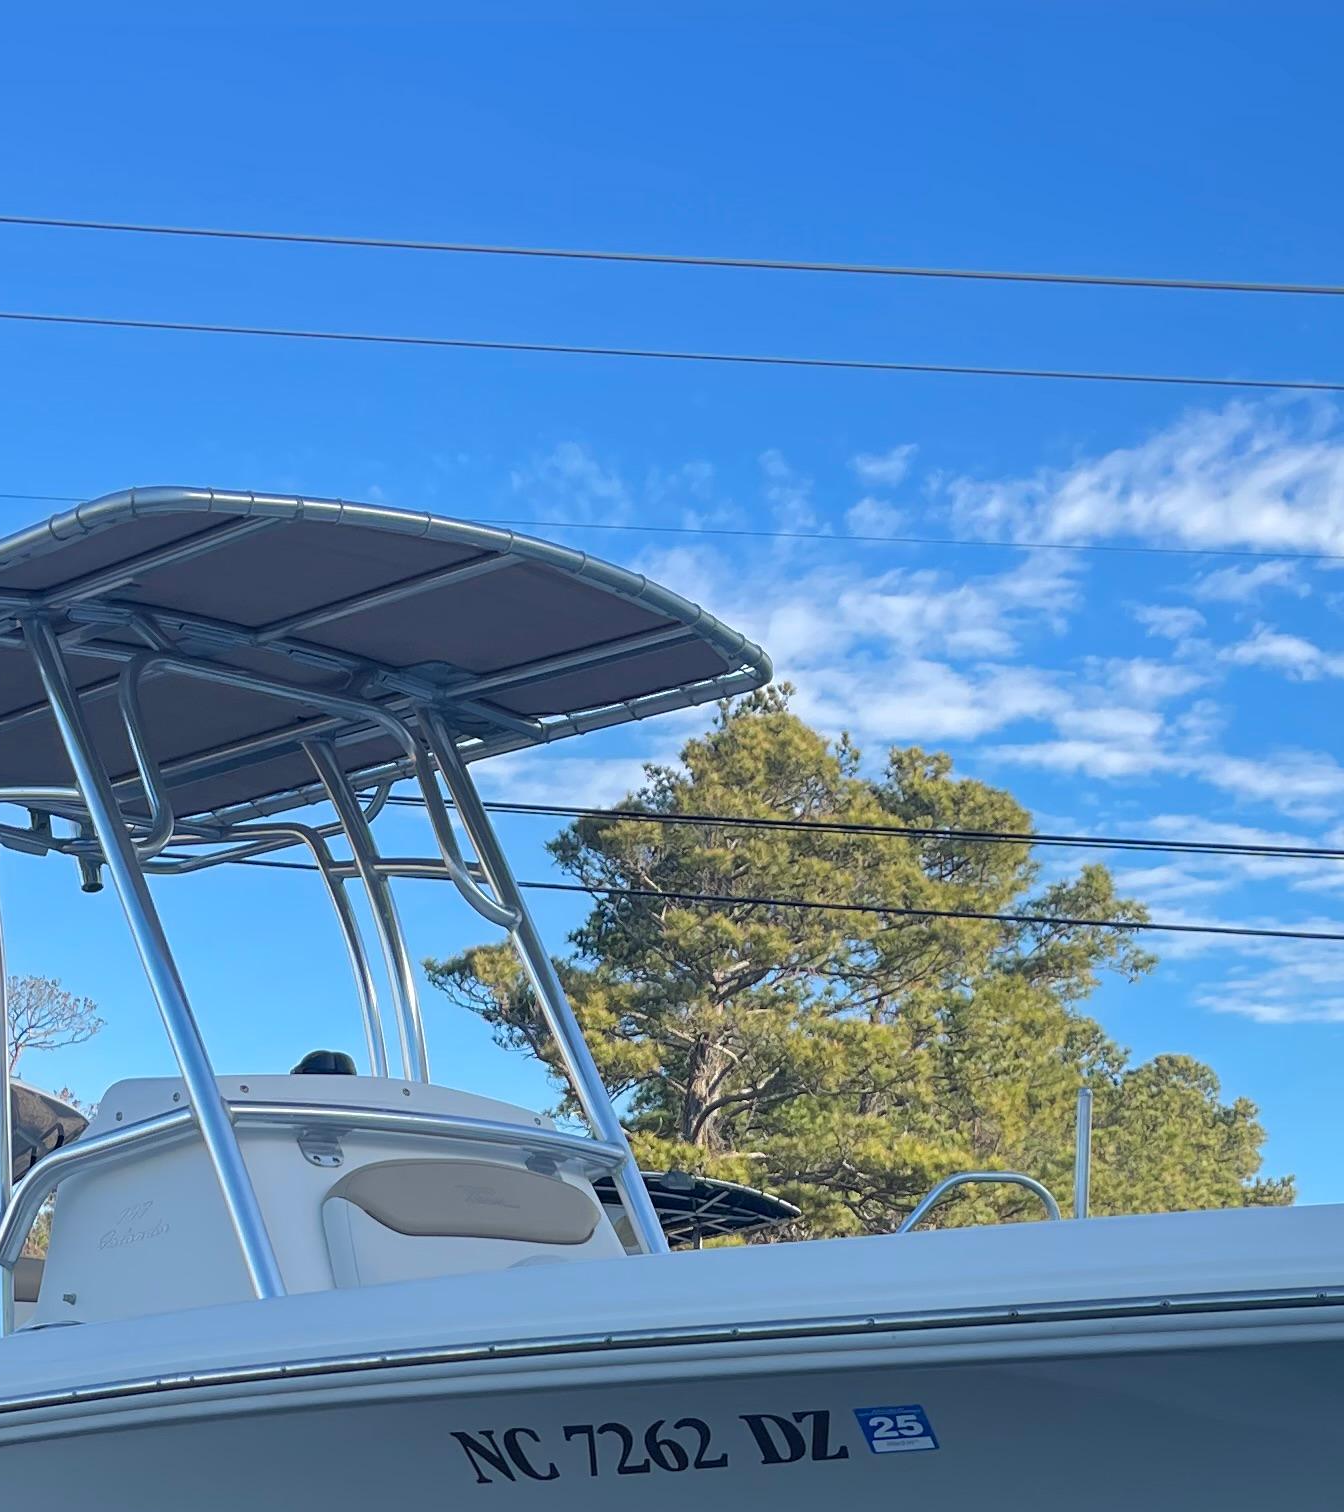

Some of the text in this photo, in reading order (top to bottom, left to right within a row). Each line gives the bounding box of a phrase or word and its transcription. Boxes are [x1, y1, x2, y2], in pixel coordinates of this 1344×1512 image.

[450, 1410, 849, 1483] NC 7262 DZ
[869, 1414, 924, 1438] 25
